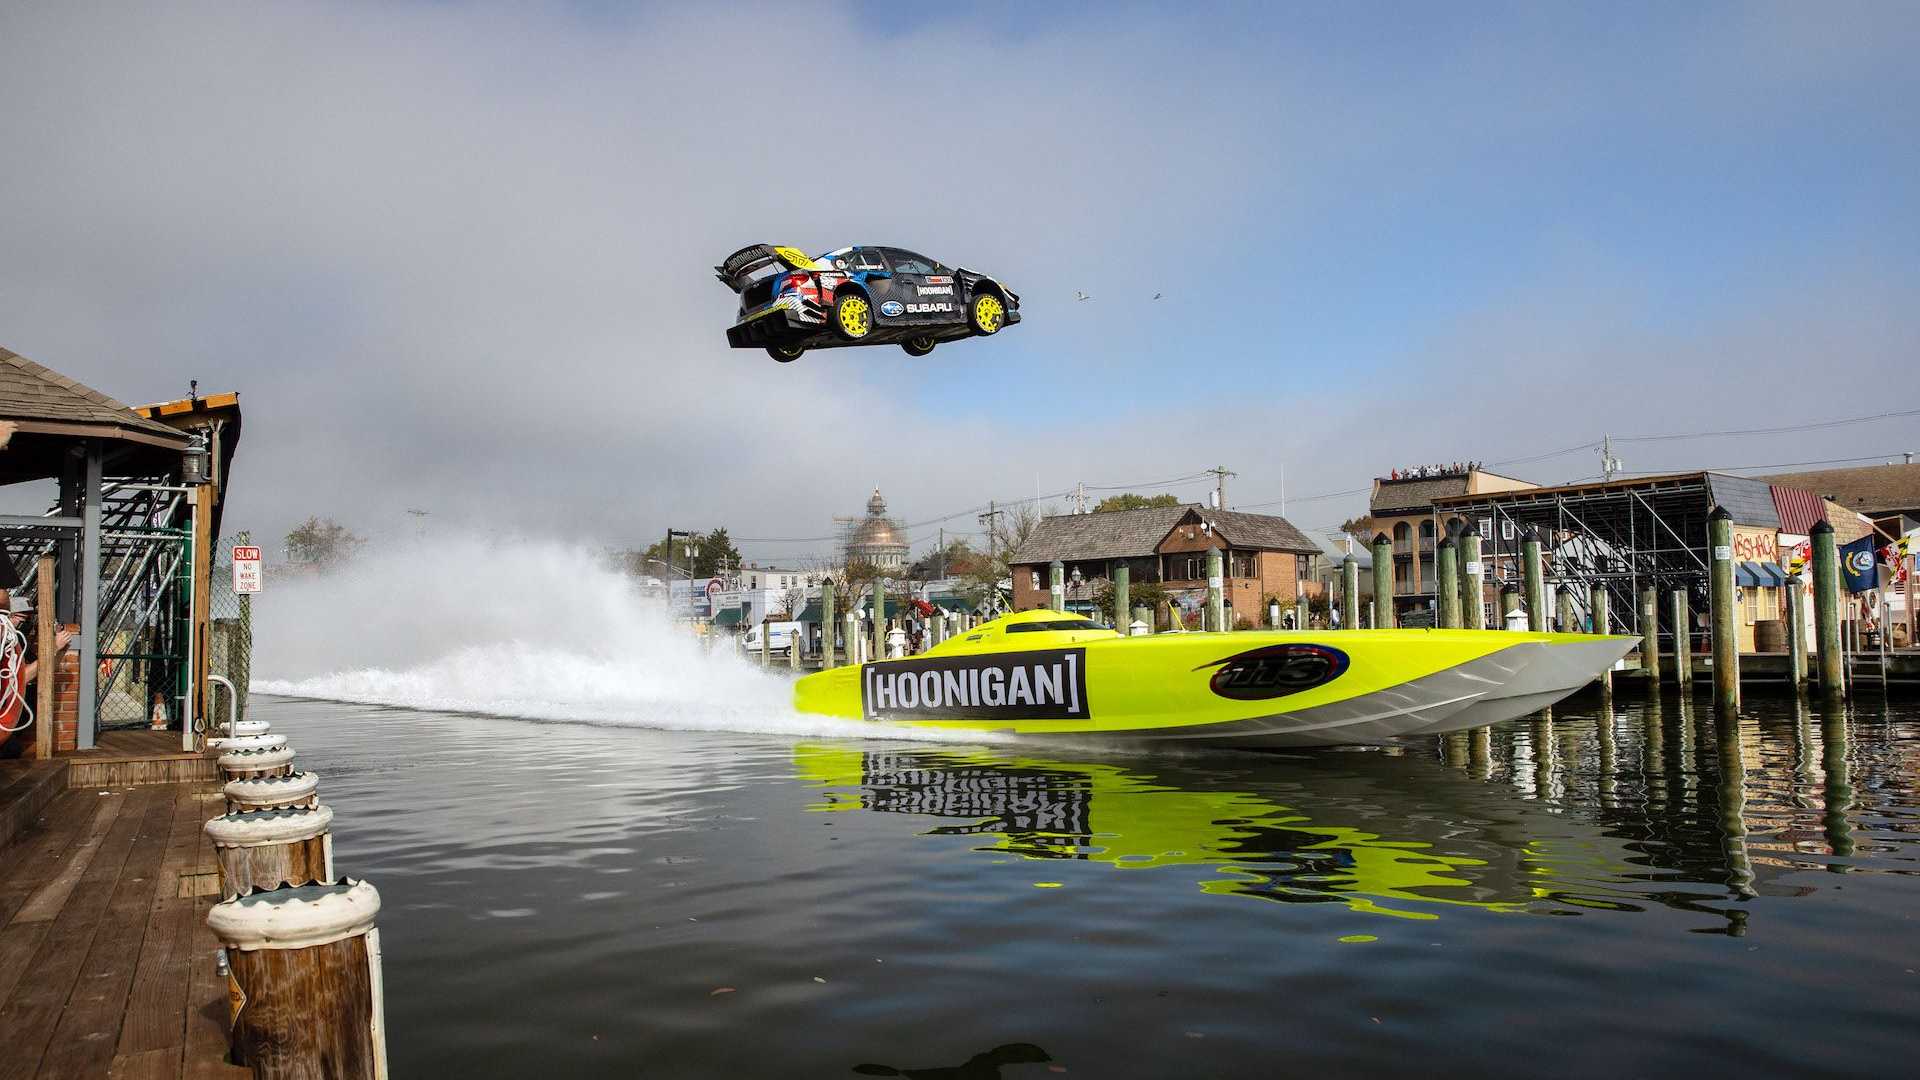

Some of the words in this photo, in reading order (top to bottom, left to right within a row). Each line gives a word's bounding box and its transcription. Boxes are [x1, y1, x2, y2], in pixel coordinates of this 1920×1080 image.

[906, 302, 953, 313] SUBARU
[236, 549, 258, 560] SLOW
[243, 562, 252, 570] NO
[240, 581, 257, 589] ZONE
